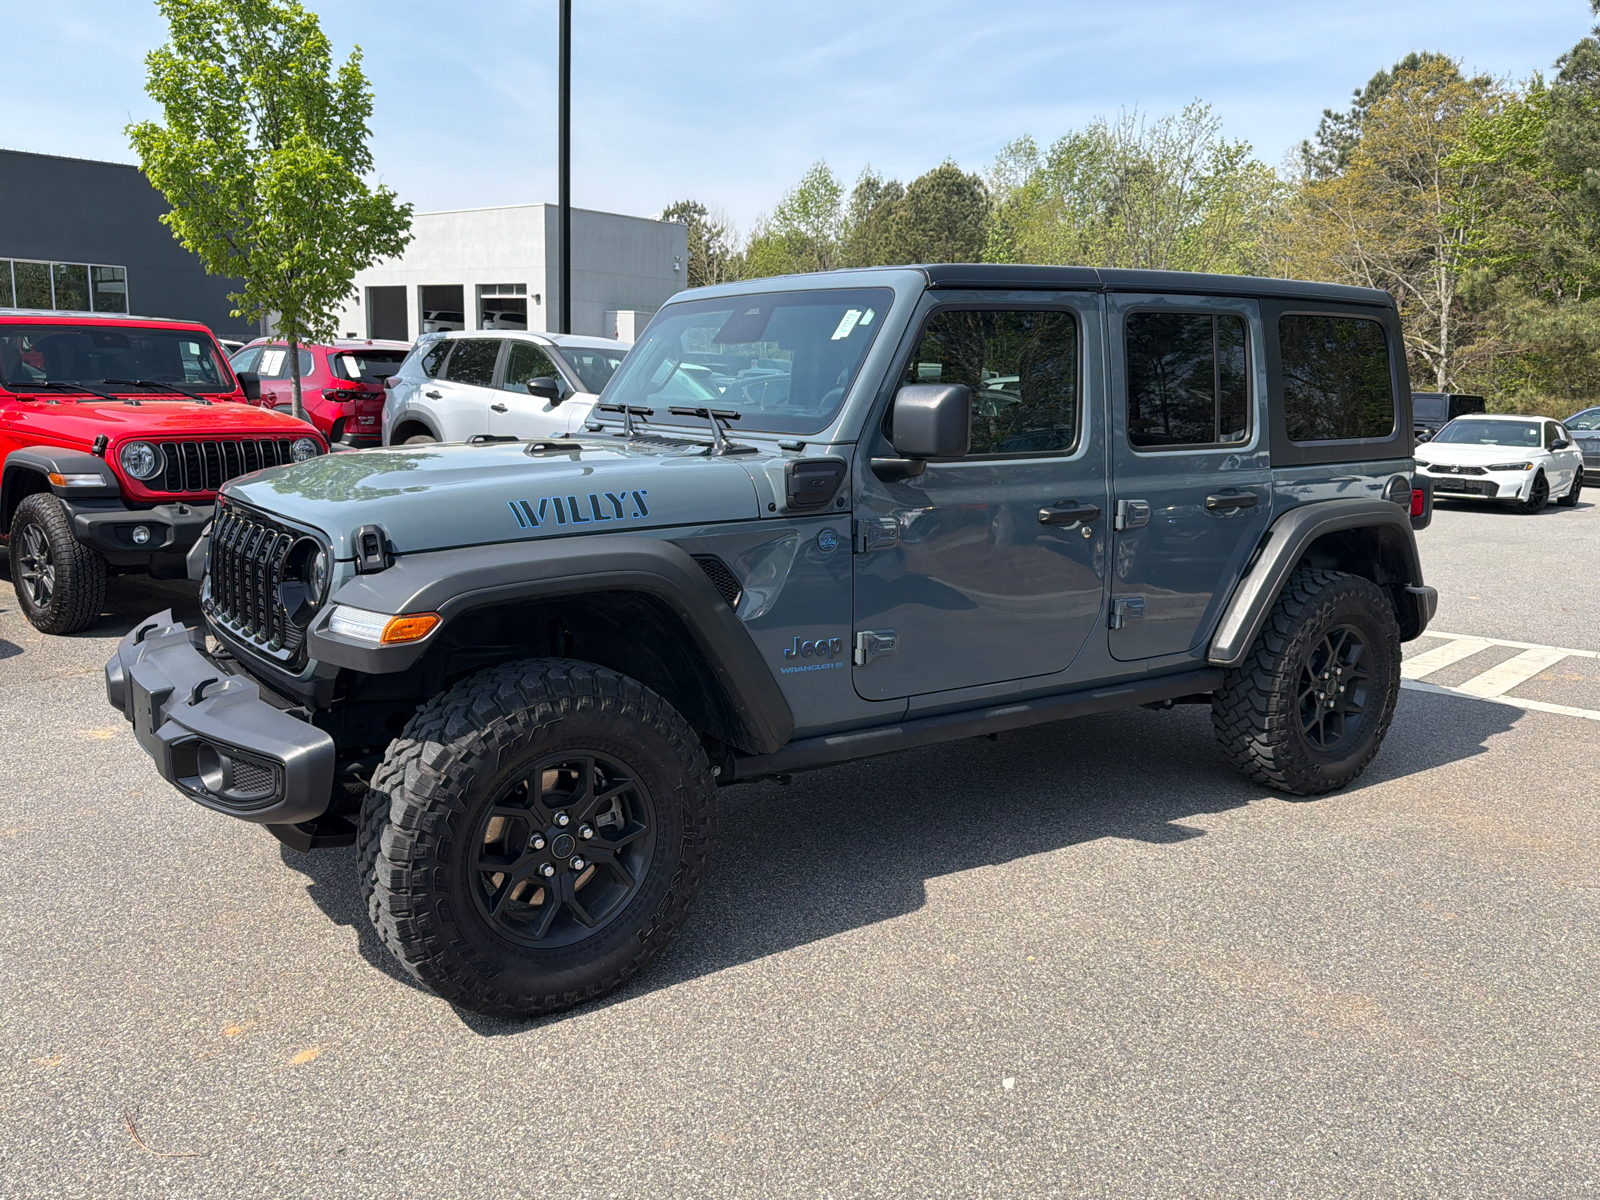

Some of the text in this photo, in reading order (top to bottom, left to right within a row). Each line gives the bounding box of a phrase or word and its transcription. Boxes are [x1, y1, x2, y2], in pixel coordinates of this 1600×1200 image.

[507, 489, 649, 529] WILLYS
[783, 636, 843, 660] Jeep
[780, 662, 835, 674] WRANGLER
[431, 774, 506, 982] WILDPEAK
